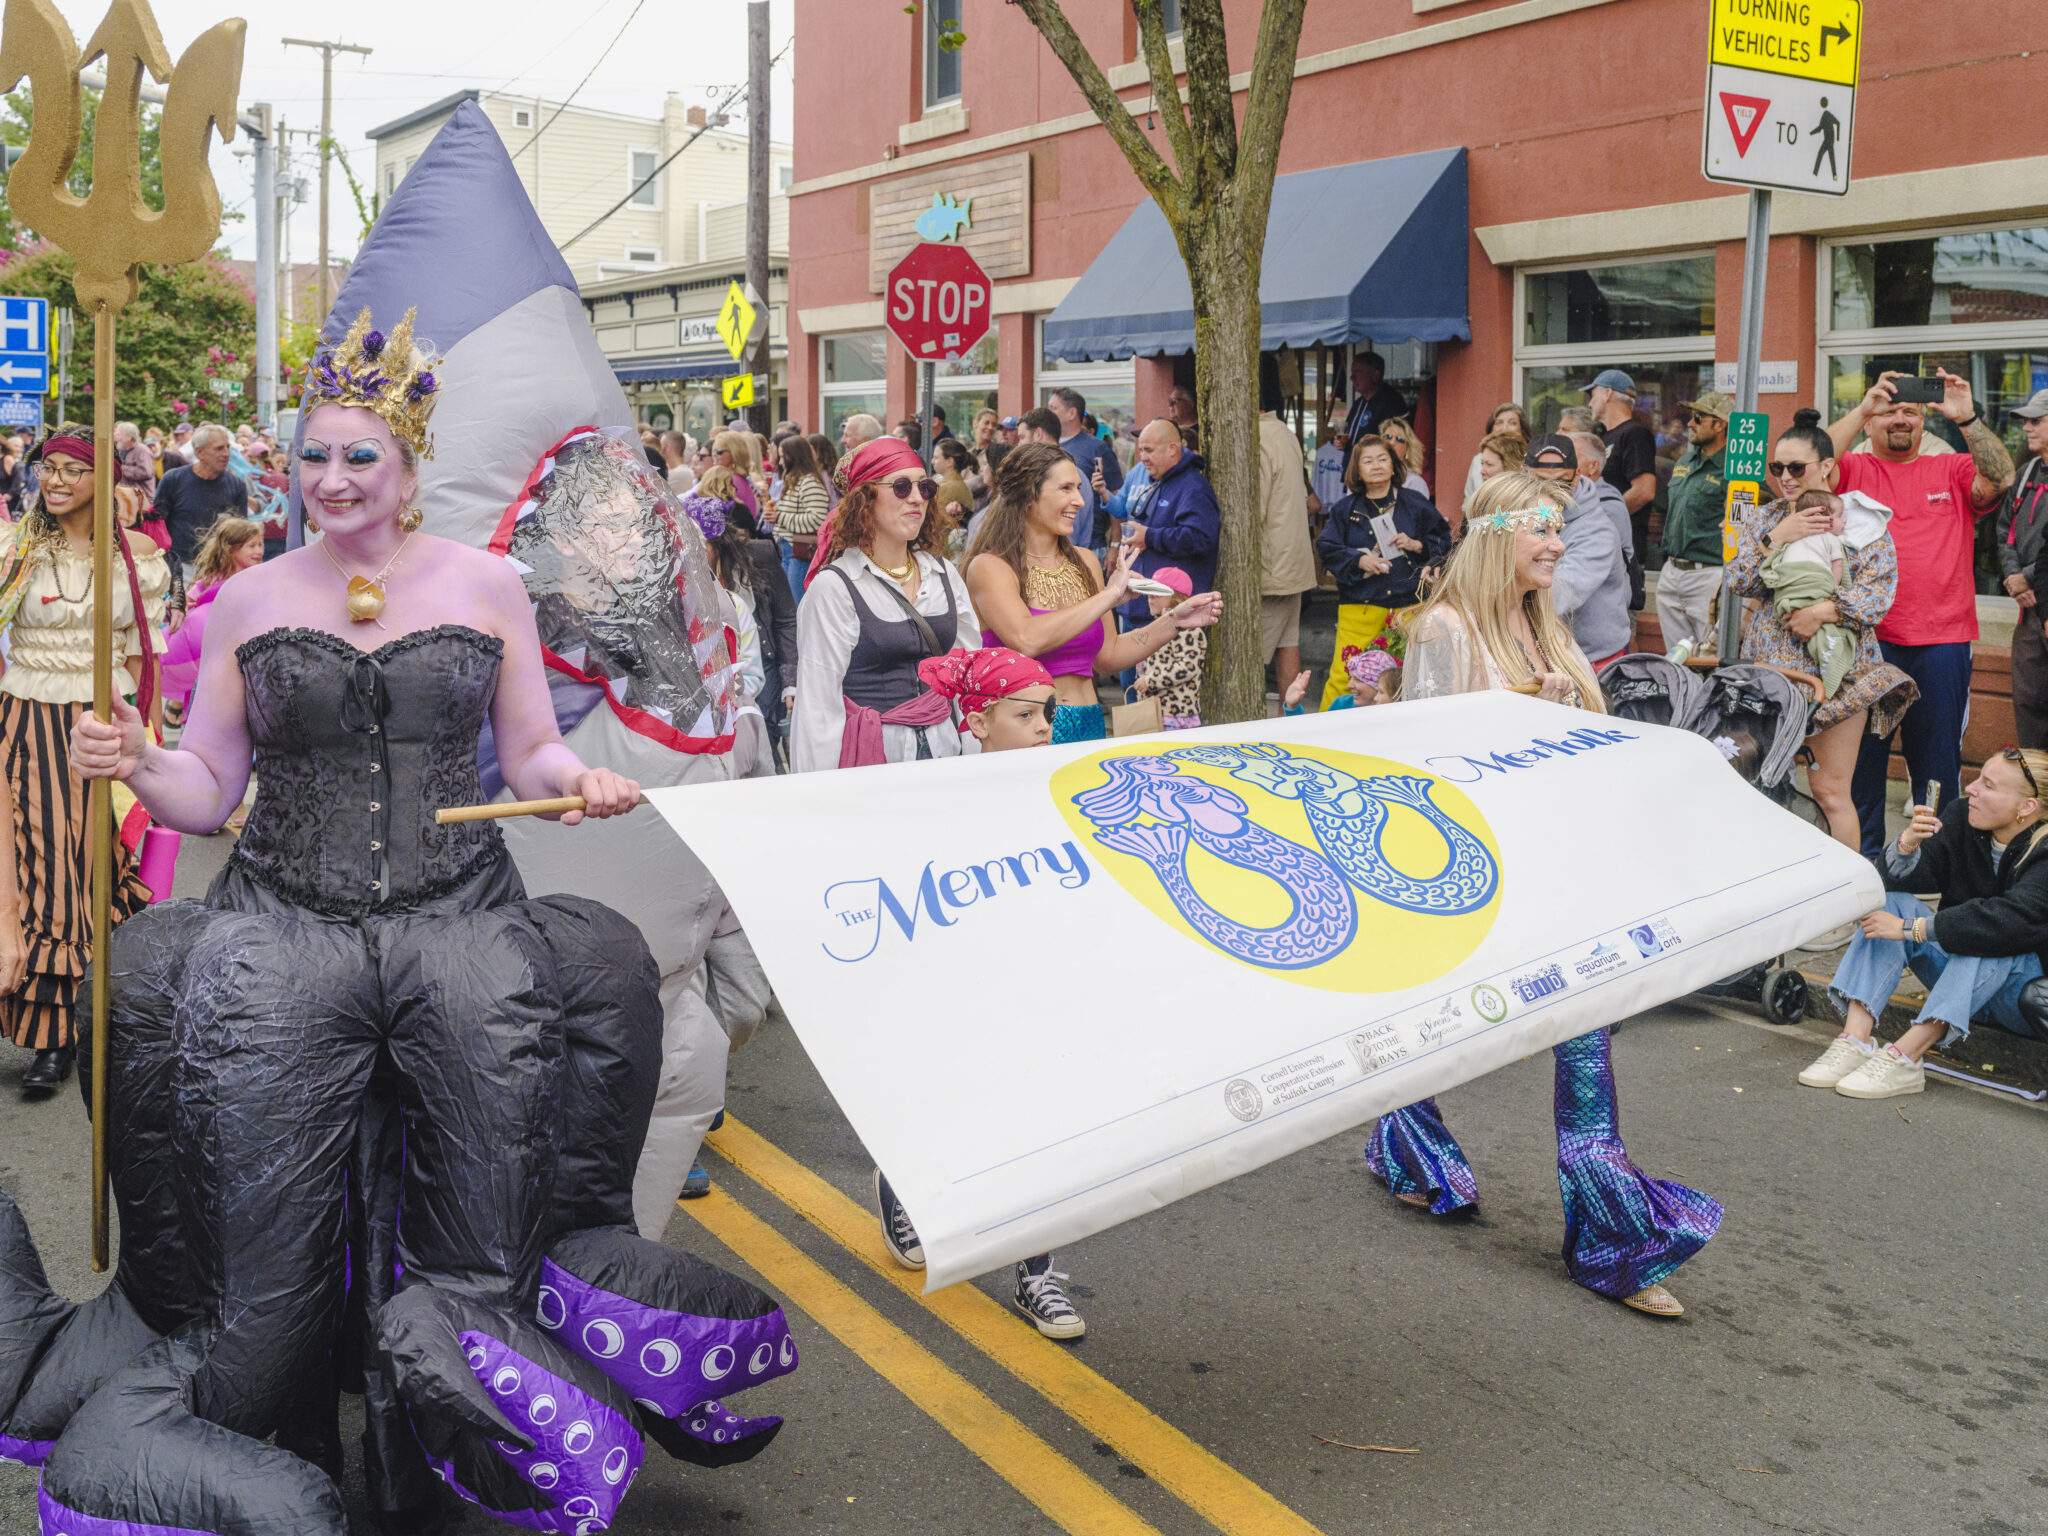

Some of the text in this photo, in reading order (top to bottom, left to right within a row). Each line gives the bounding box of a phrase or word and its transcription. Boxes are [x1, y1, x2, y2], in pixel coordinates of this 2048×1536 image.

[1723, 27, 1810, 63] VEHICLES
[1736, 108, 1753, 118] YIELD
[1776, 121, 1798, 145] TO
[893, 277, 986, 325] STOP
[0, 300, 38, 350] H
[1739, 418, 1756, 434] 25
[1730, 438, 1764, 455] 0704
[1730, 459, 1762, 475] 1662
[1425, 728, 1640, 783] Merfolk
[822, 840, 1091, 963] THE Merry
[1657, 926, 1676, 939] end
[1663, 935, 1682, 949] arts
[1576, 952, 1621, 975] aquarium
[1521, 974, 1562, 1000] BID
[1365, 1023, 1394, 1041] BACK
[1372, 1033, 1402, 1052] TO THE
[1378, 1046, 1408, 1064] BAYS
[1261, 1054, 1325, 1083] Cornell University
[1267, 1059, 1345, 1094] Cooperative Extension
[1273, 1075, 1335, 1106] of Suffolk County
